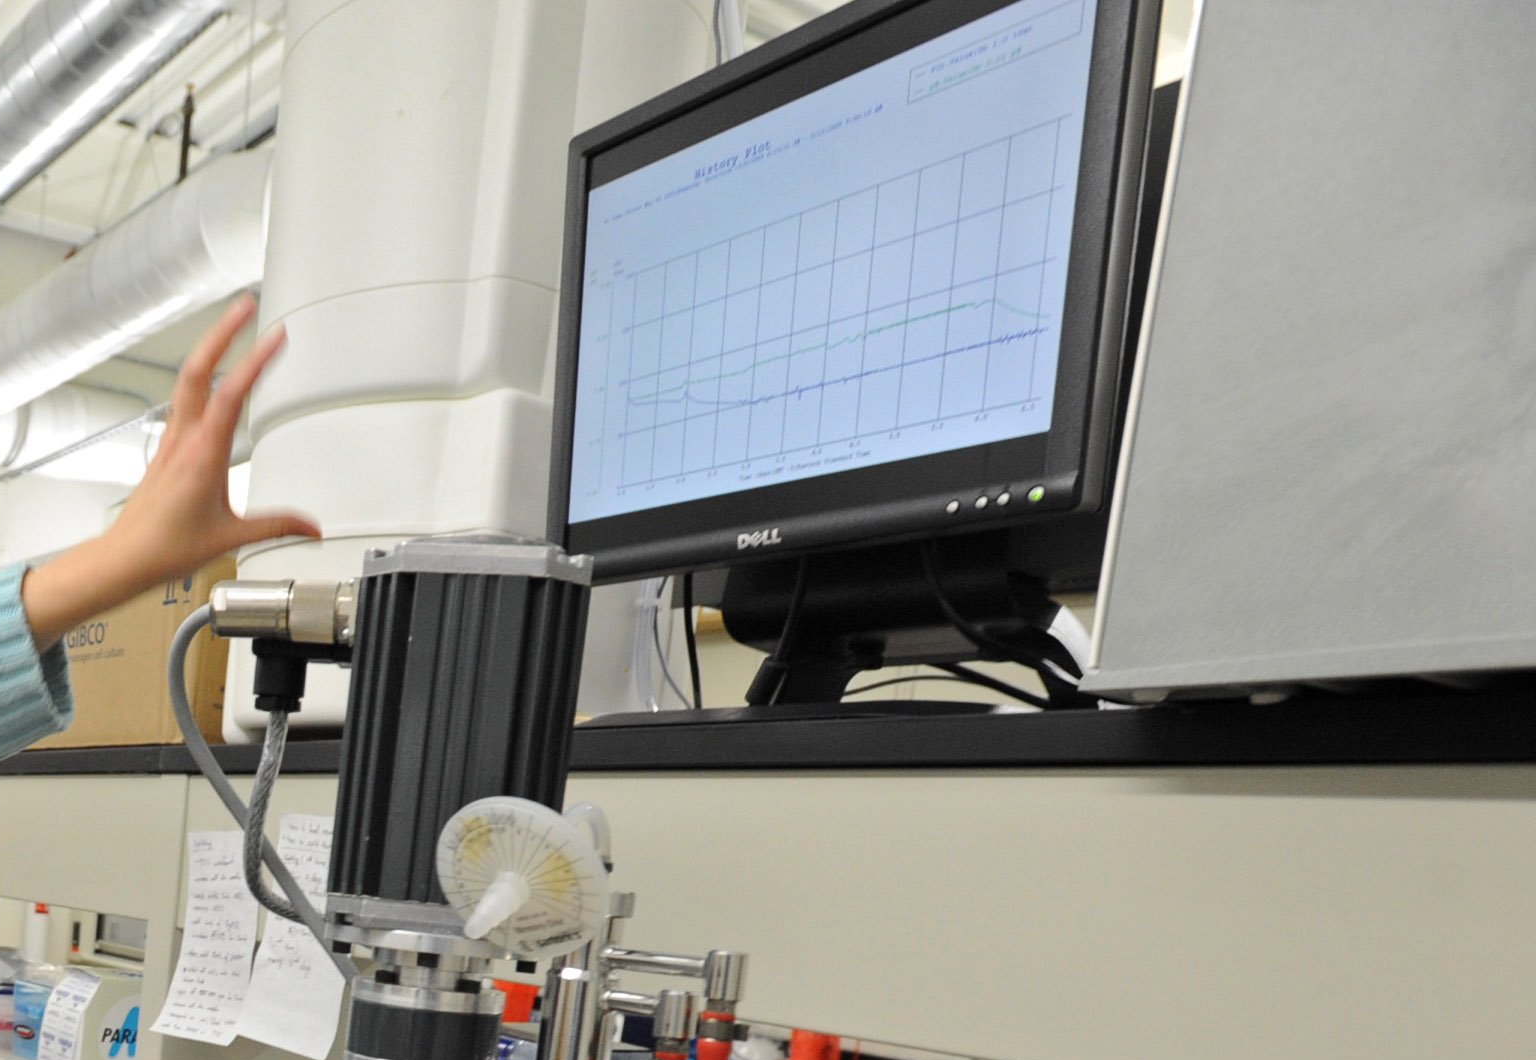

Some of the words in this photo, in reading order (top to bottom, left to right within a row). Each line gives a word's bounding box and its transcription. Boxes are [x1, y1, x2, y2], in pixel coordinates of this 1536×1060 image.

[694, 154, 739, 181] History
[745, 140, 772, 159] Plot
[737, 527, 782, 550] DELL
[67, 622, 105, 648] GIBCO
